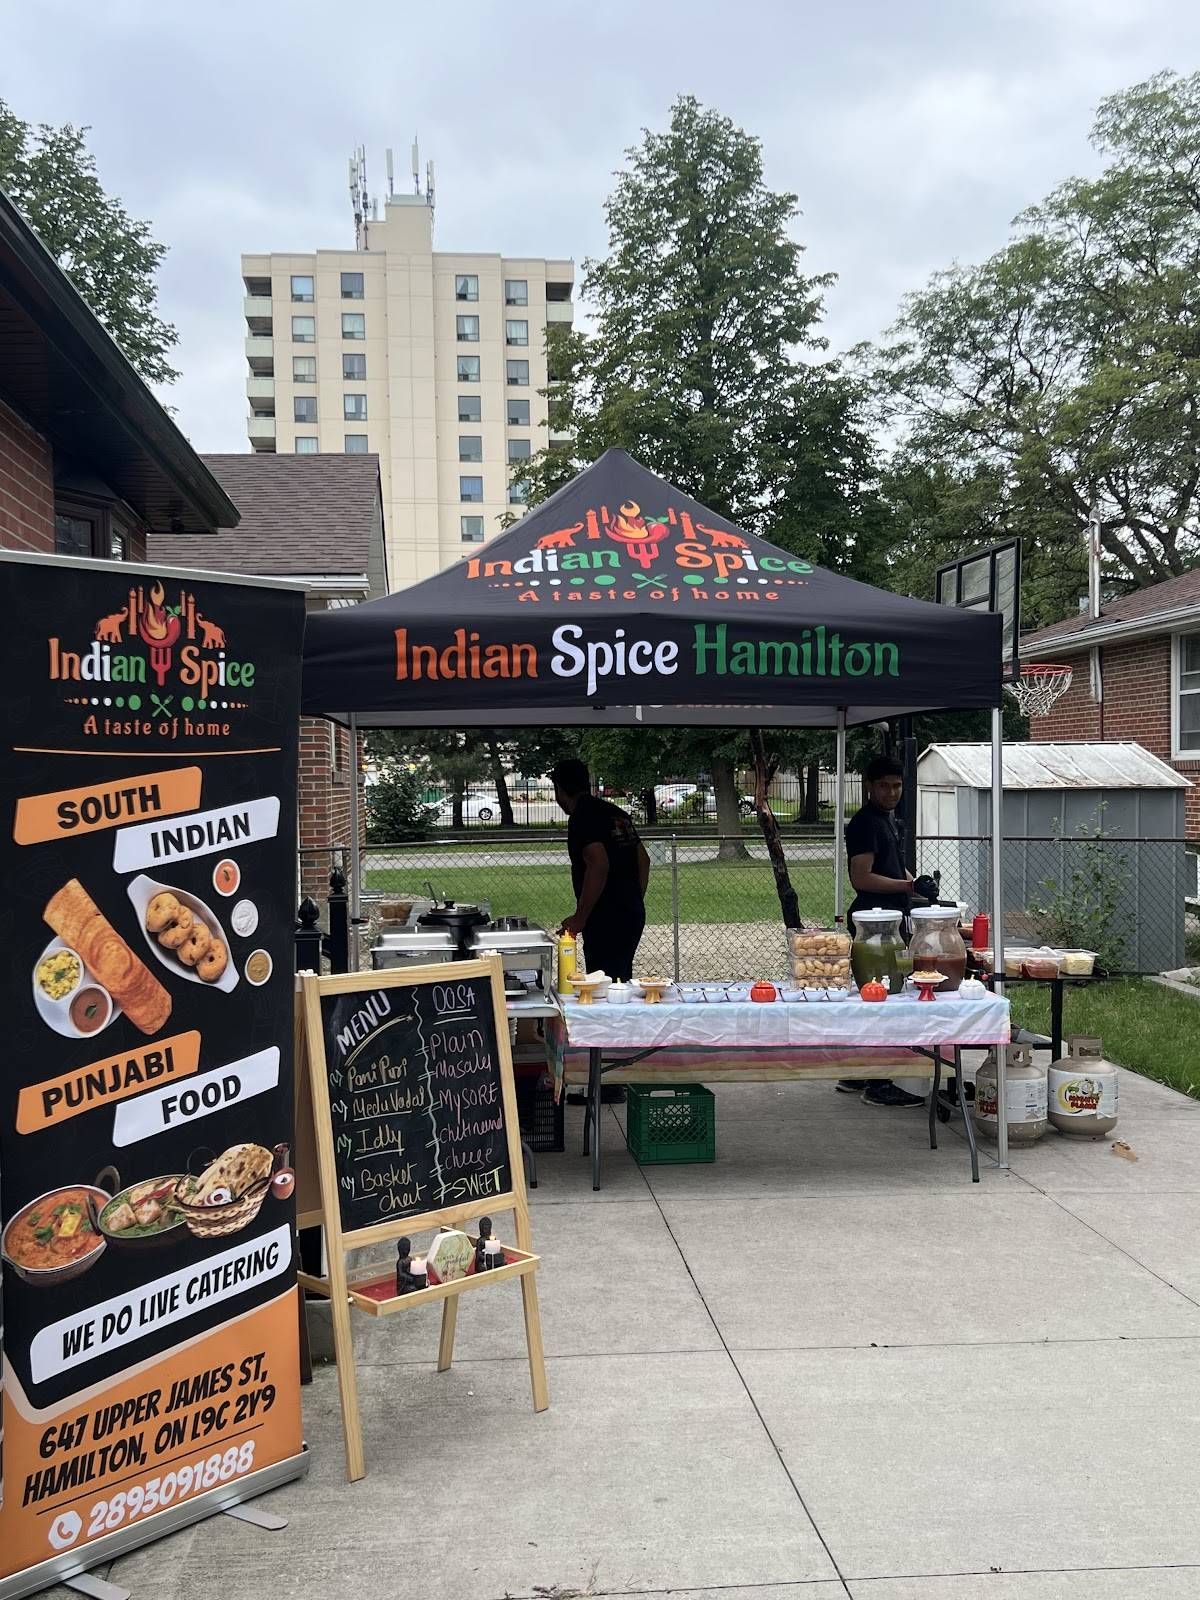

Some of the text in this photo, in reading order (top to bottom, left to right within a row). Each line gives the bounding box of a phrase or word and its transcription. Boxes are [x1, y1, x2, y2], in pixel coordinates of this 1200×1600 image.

[467, 542, 814, 579] Indian Spice
[518, 587, 779, 602] A taste of home
[48, 637, 255, 699] Indian Spice
[395, 624, 899, 695] Indian Spice Hamilton
[83, 714, 230, 739] A taste of home
[57, 784, 161, 829] SOUTH
[150, 812, 250, 858] INDIAN
[337, 990, 391, 1055] MENU
[41, 1047, 175, 1117] PUNJABI
[161, 1075, 242, 1124] FOOD
[361, 1162, 418, 1191] Basket
[452, 1165, 504, 1198] SWEET
[63, 1242, 279, 1360] WE DO LIVE CATERING
[39, 1352, 268, 1458] 647 UPPER JAMES ST,
[22, 1384, 276, 1508] HAMILTON, ON L9C 2Y9
[86, 1440, 256, 1537] 2893091888
